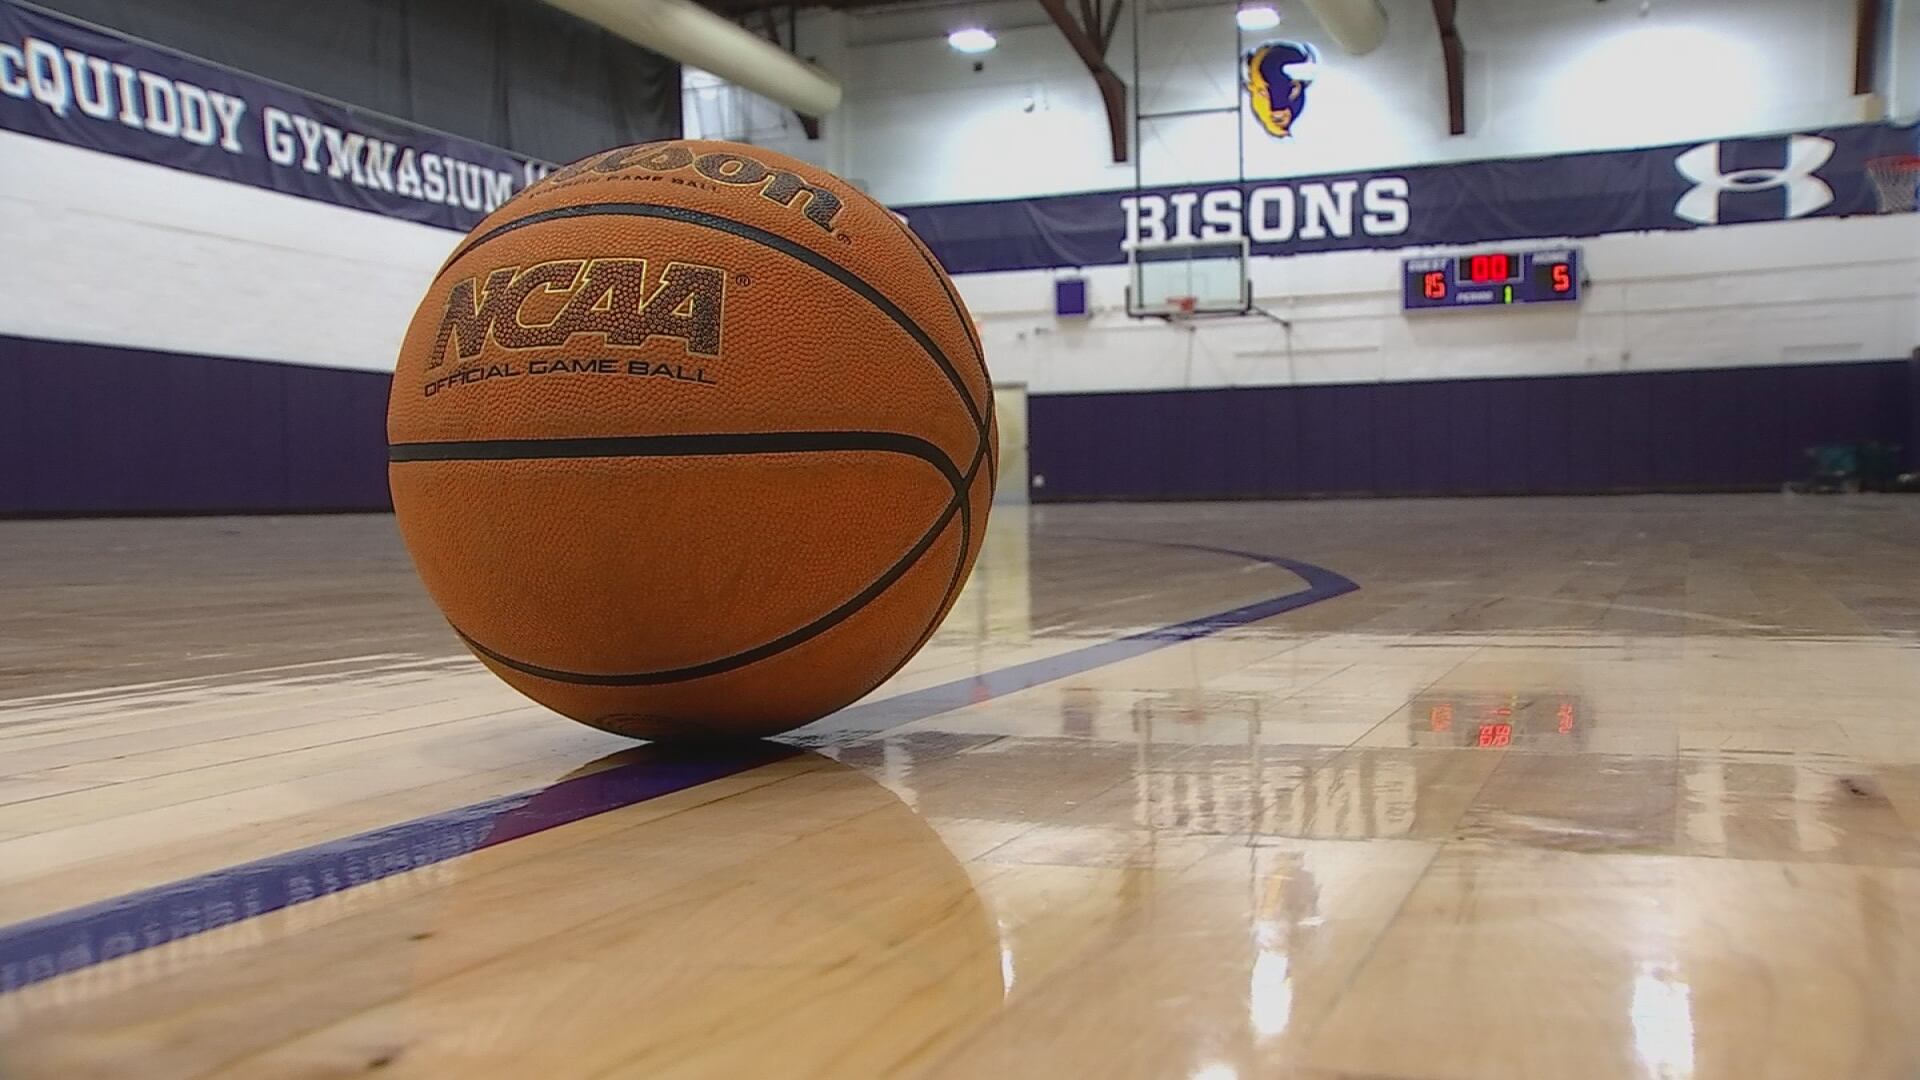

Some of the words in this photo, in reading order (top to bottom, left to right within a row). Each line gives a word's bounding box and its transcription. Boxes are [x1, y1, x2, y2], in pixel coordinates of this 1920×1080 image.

[264, 106, 513, 213] GYMNASIUM
[1120, 176, 1410, 250] BISONS
[1424, 271, 1446, 299] 15
[1553, 264, 1570, 291] 5
[424, 258, 726, 374] NCAA
[424, 363, 521, 397] OFFICIAL
[528, 359, 620, 376] GAME
[627, 360, 717, 385] BALL
